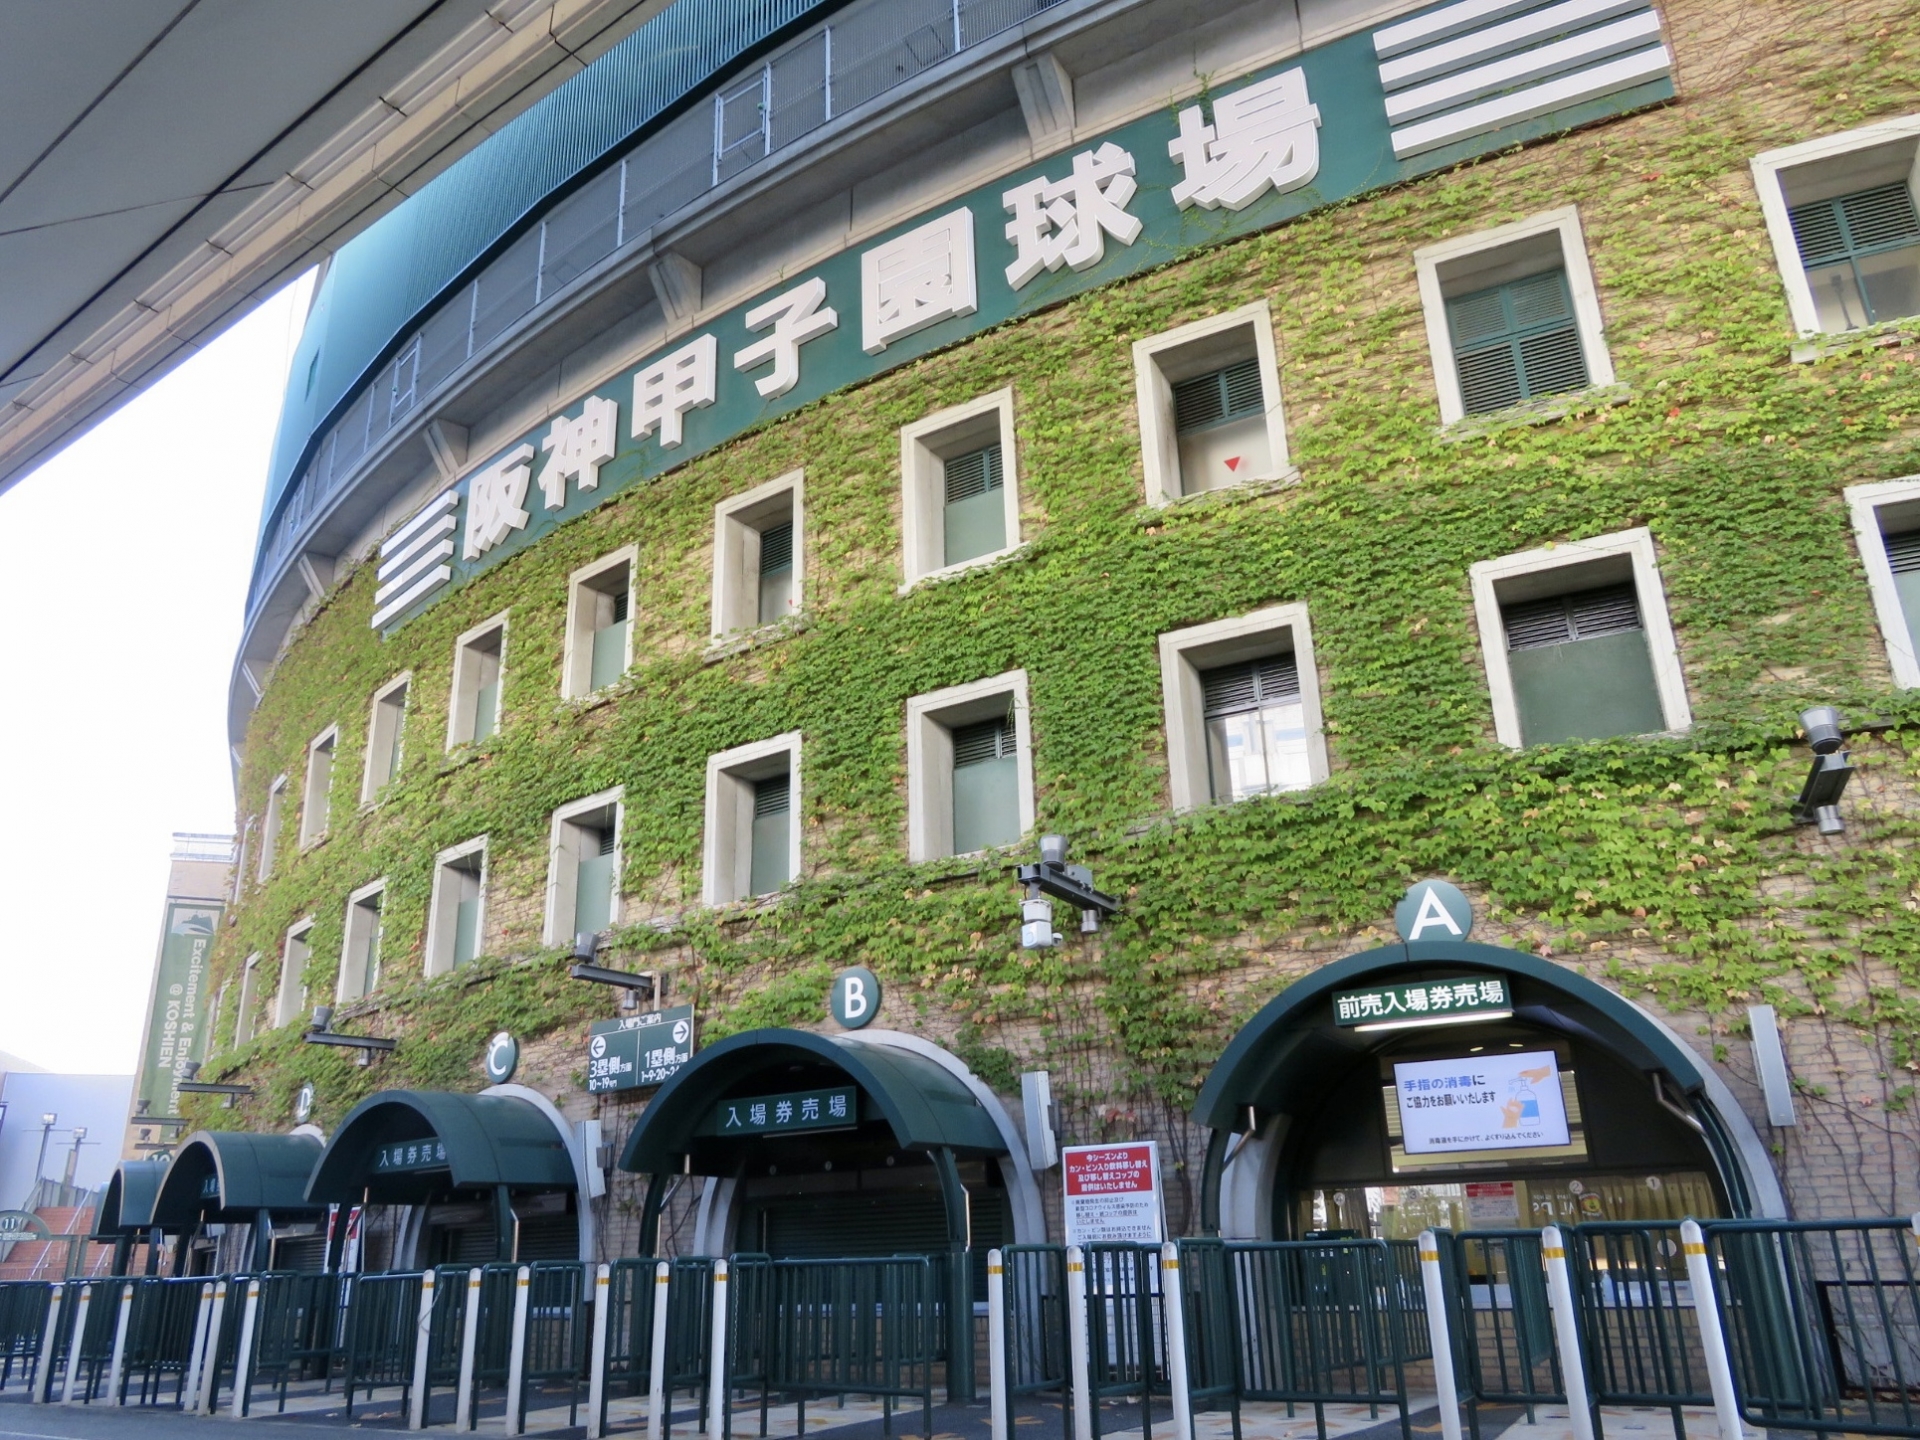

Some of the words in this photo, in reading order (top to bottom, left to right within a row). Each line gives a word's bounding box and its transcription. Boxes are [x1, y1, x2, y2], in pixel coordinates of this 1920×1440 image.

[462, 66, 1321, 563] 阪神甲子園球場
[1408, 886, 1463, 940] A
[169, 983, 183, 996] @
[183, 938, 207, 1018] Excitement
[845, 977, 867, 1019] B
[1338, 980, 1504, 1019] 前売入場券売場
[158, 1000, 181, 1068] KOSHIEN
[180, 1022, 195, 1034] &
[489, 1039, 509, 1075] C
[1403, 1074, 1486, 1092] 手指の消毒に
[1406, 1091, 1497, 1109] ご協力をお願いいたします
[726, 1095, 847, 1128] 入場券売場
[1086, 1151, 1129, 1163] 今シーズンより
[5, 1218, 15, 1229] 11
